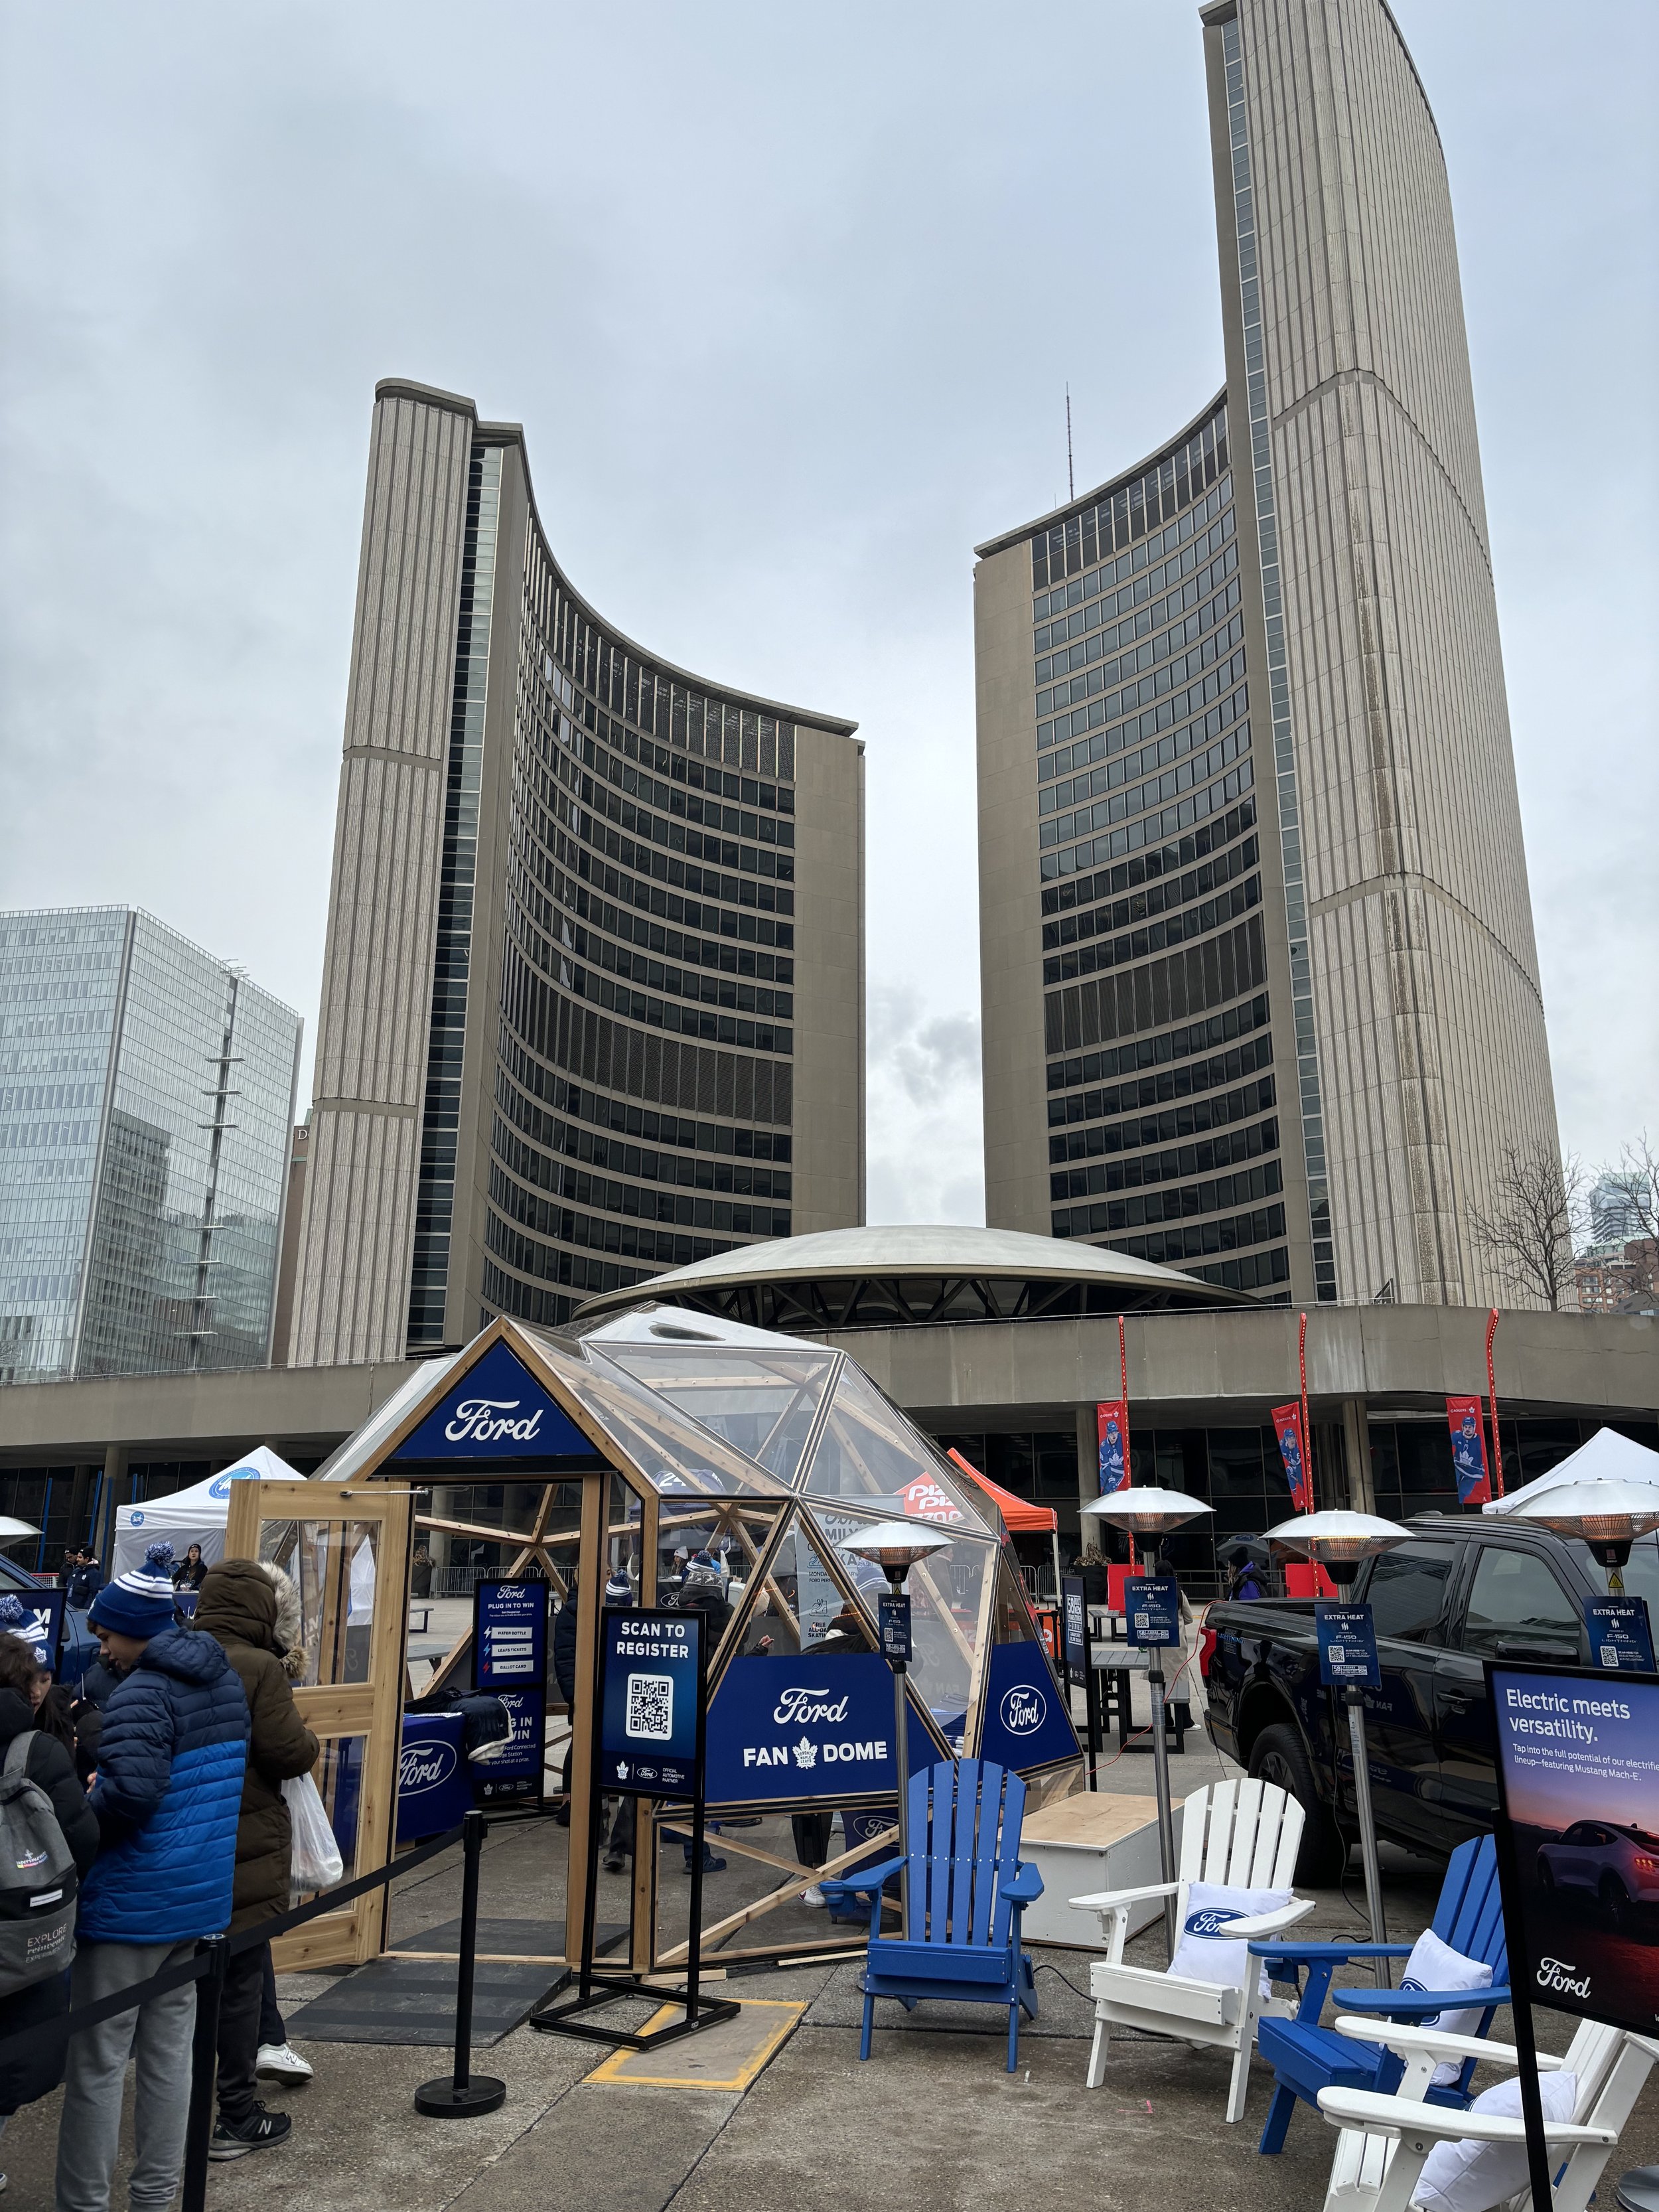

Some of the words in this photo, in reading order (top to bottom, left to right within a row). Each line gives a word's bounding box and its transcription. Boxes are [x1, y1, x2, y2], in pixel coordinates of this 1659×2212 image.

[445, 1399, 544, 1441] Ford
[496, 1585, 526, 1599] Ford
[1067, 1596, 1074, 1615] 58
[620, 1621, 661, 1637] SCAN
[665, 1623, 685, 1638] TO
[616, 1641, 689, 1659] REGISTER
[498, 1694, 524, 1709] Ford
[773, 1688, 849, 1724] Ford
[1009, 1692, 1039, 1728] Ford
[1506, 1688, 1569, 1713] Electric
[1573, 1698, 1630, 1720] meets
[520, 1716, 532, 1728] IN
[1508, 1716, 1598, 1744] versatility.
[743, 1746, 788, 1767] FAN
[823, 1741, 888, 1763] DOME
[1512, 1743, 1526, 1754] Tap
[1526, 1745, 1540, 1755] into
[1542, 1747, 1553, 1757] the
[1554, 1748, 1567, 1758] full
[1568, 1751, 1601, 1763] potential
[1603, 1755, 1611, 1764] of
[1626, 1758, 1659, 1771] electrifie
[399, 1747, 444, 1788] Ford
[1575, 1763, 1608, 1778] Mustang
[27, 1923, 67, 1947] EXPLORE
[1536, 1957, 1591, 1998] Ford
